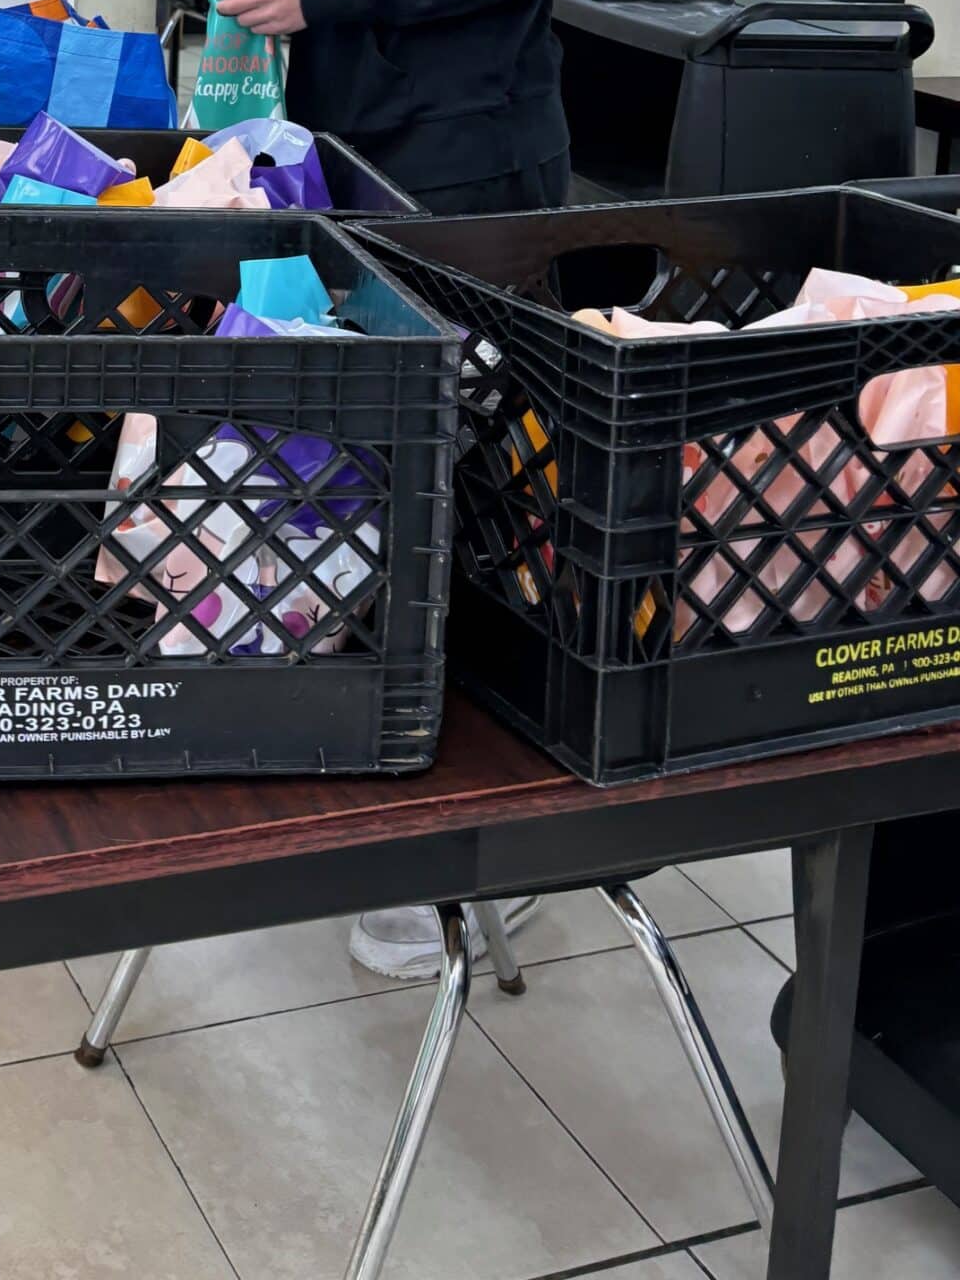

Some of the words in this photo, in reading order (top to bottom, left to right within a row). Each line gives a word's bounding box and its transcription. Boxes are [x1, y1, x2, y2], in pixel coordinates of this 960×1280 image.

[202, 55, 272, 75] HOORAY
[816, 640, 881, 667] CLOVER
[886, 628, 944, 655] FARMS
[947, 625, 960, 645] D
[881, 662, 895, 675] PA
[0, 676, 58, 687] PROPERTY
[60, 675, 79, 685] OF:
[15, 685, 99, 701] FARMS
[107, 681, 182, 699] DAIRY
[808, 691, 824, 704] USE
[825, 689, 836, 700] BY
[837, 684, 865, 698] OTHER
[91, 700, 125, 715] PA
[17, 732, 58, 743] OWNER
[60, 729, 129, 741] PUNISHABLE
[130, 729, 146, 739] BY
[147, 727, 171, 738] LAW
